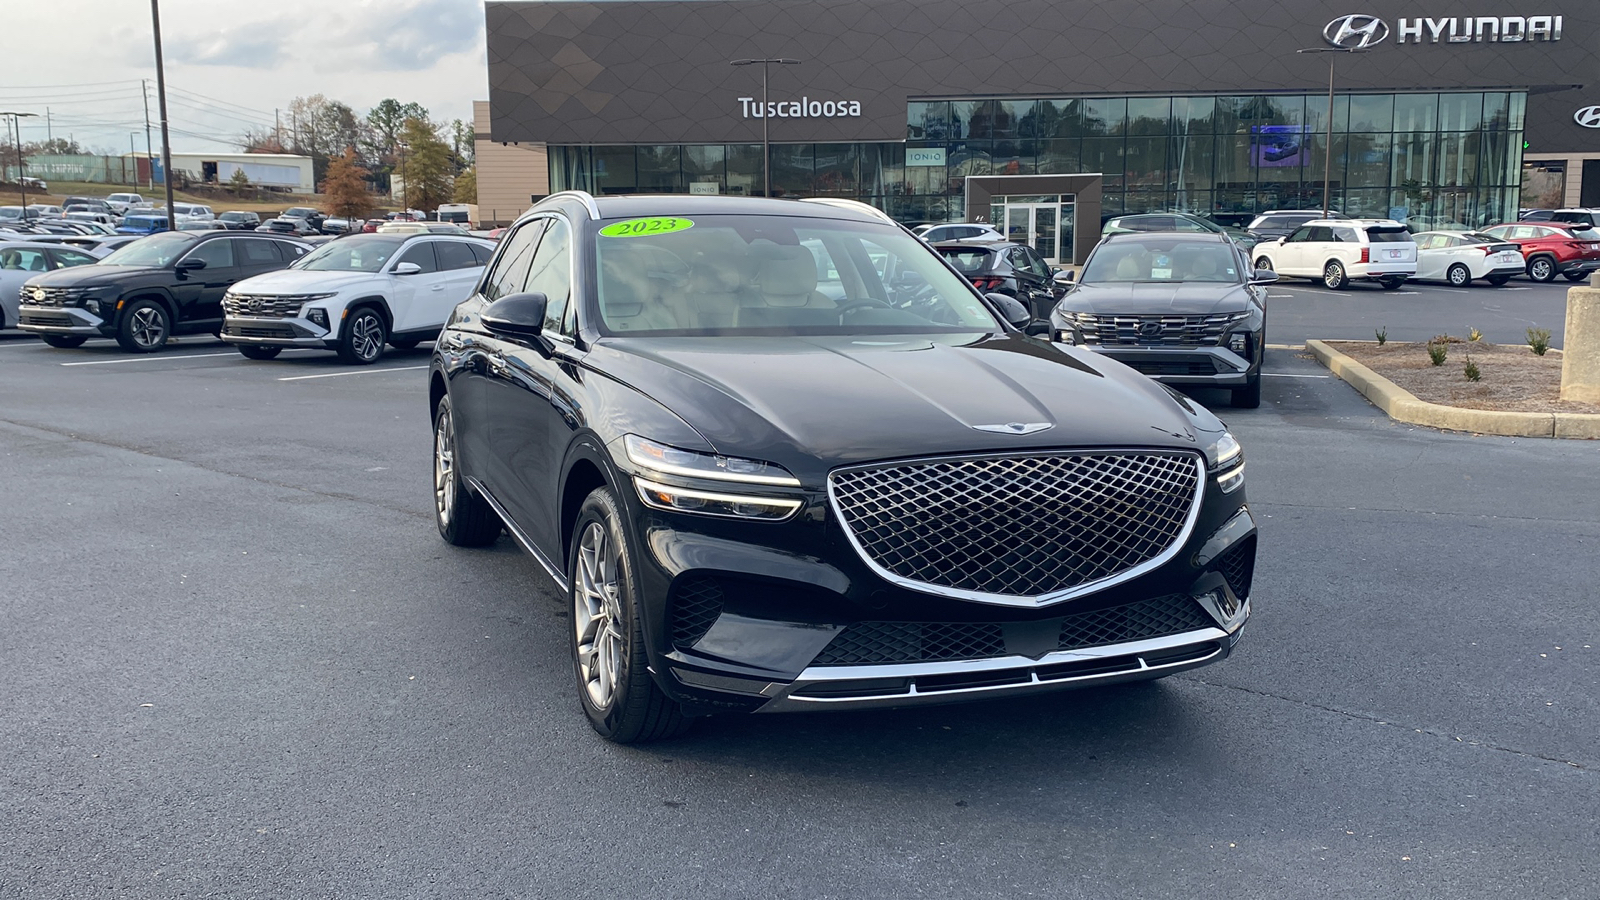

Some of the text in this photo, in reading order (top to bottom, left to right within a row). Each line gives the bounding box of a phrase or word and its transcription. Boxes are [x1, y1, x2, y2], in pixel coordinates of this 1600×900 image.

[1397, 15, 1563, 44] HYUNDAI
[737, 96, 861, 118] Tuscaloosa
[617, 219, 677, 235] 2023
